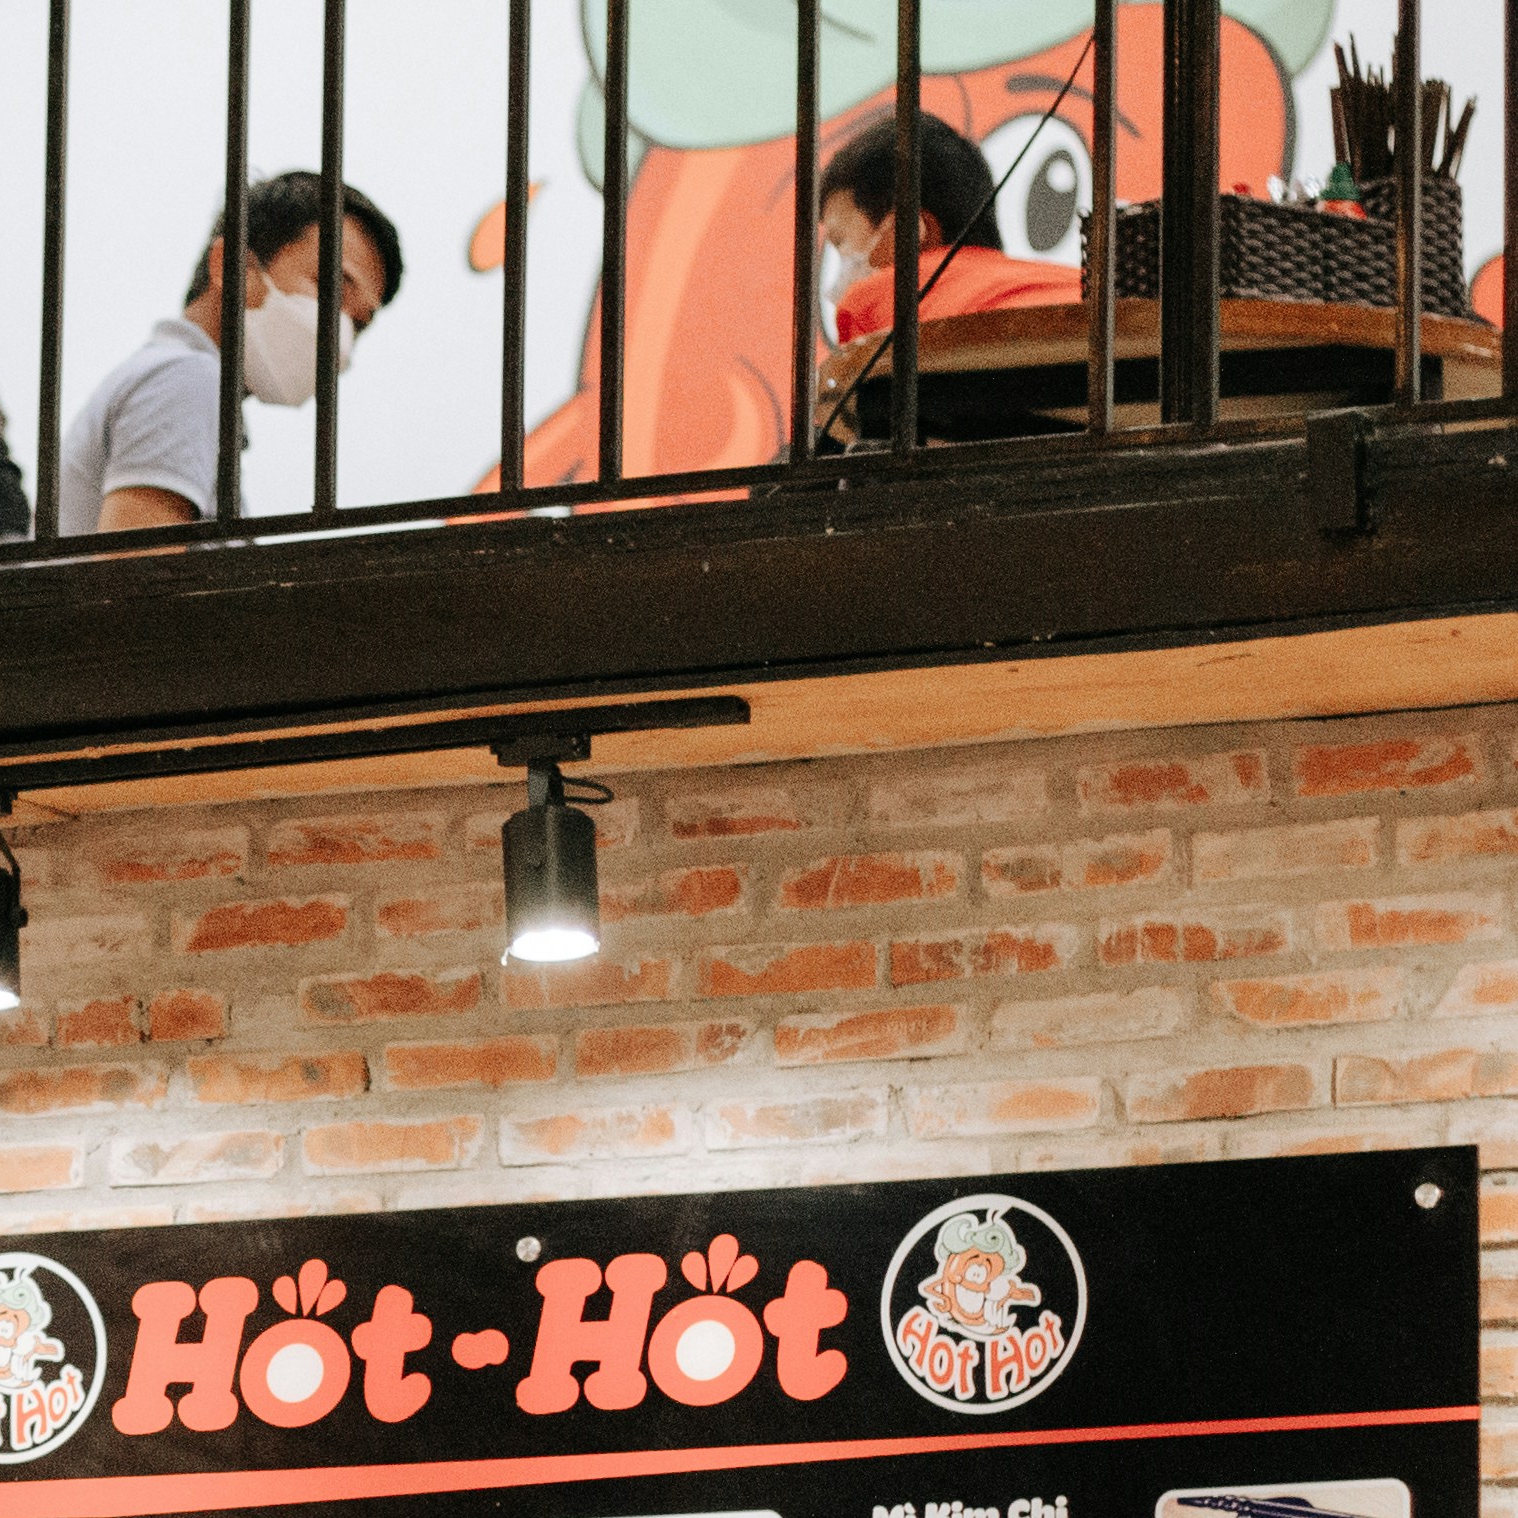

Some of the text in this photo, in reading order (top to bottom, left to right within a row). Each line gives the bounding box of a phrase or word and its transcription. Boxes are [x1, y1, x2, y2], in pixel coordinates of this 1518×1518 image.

[898, 1307, 1063, 1397] Hot Hot
[13, 1367, 83, 1447] Hot
